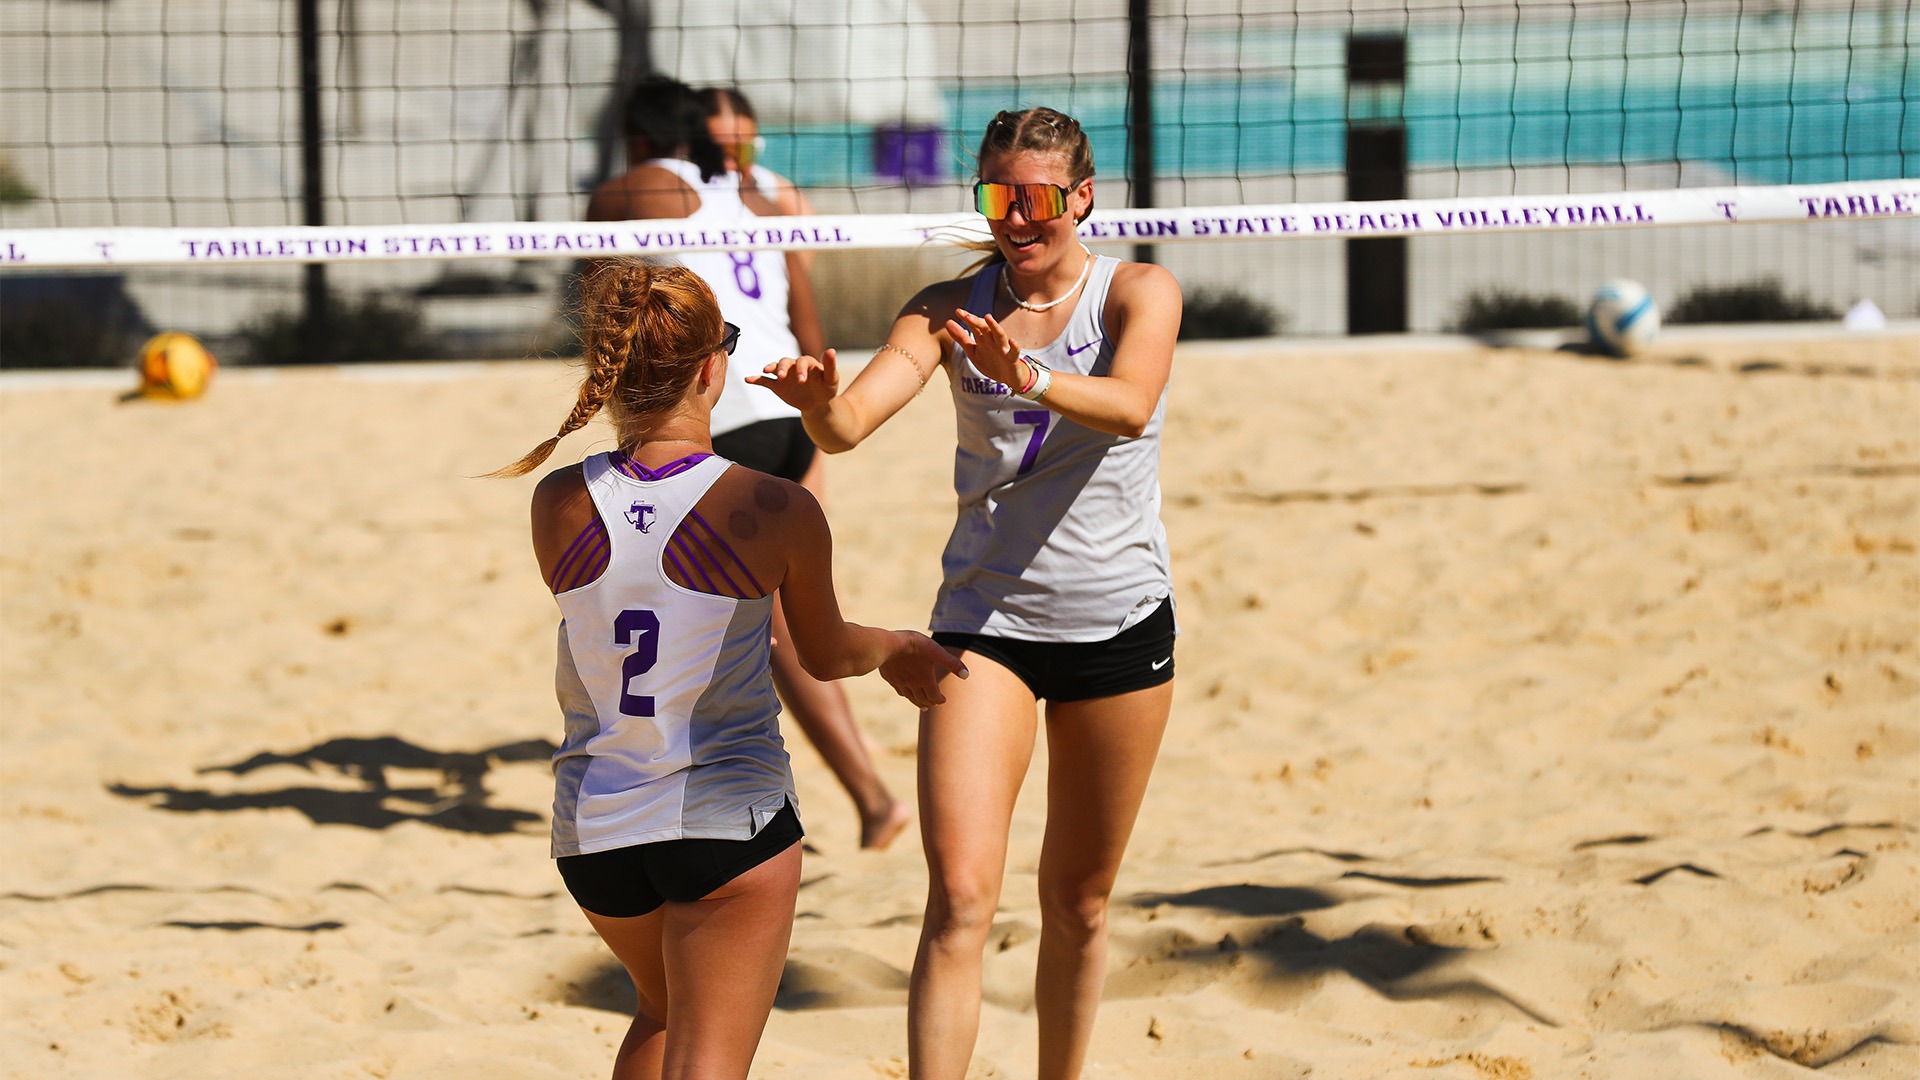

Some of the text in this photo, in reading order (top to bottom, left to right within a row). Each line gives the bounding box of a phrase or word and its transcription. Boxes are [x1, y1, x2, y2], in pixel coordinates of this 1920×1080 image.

[1078, 203, 1656, 238] ETON STATE BEACH VOLLEYBALL
[1799, 193, 1920, 219] TARLE
[181, 227, 852, 258] TARLETON STATE BEACH VOLLEYBALL
[728, 250, 761, 300] 8
[1013, 410, 1051, 476] 7
[629, 502, 656, 530] T
[613, 609, 661, 718] 2
